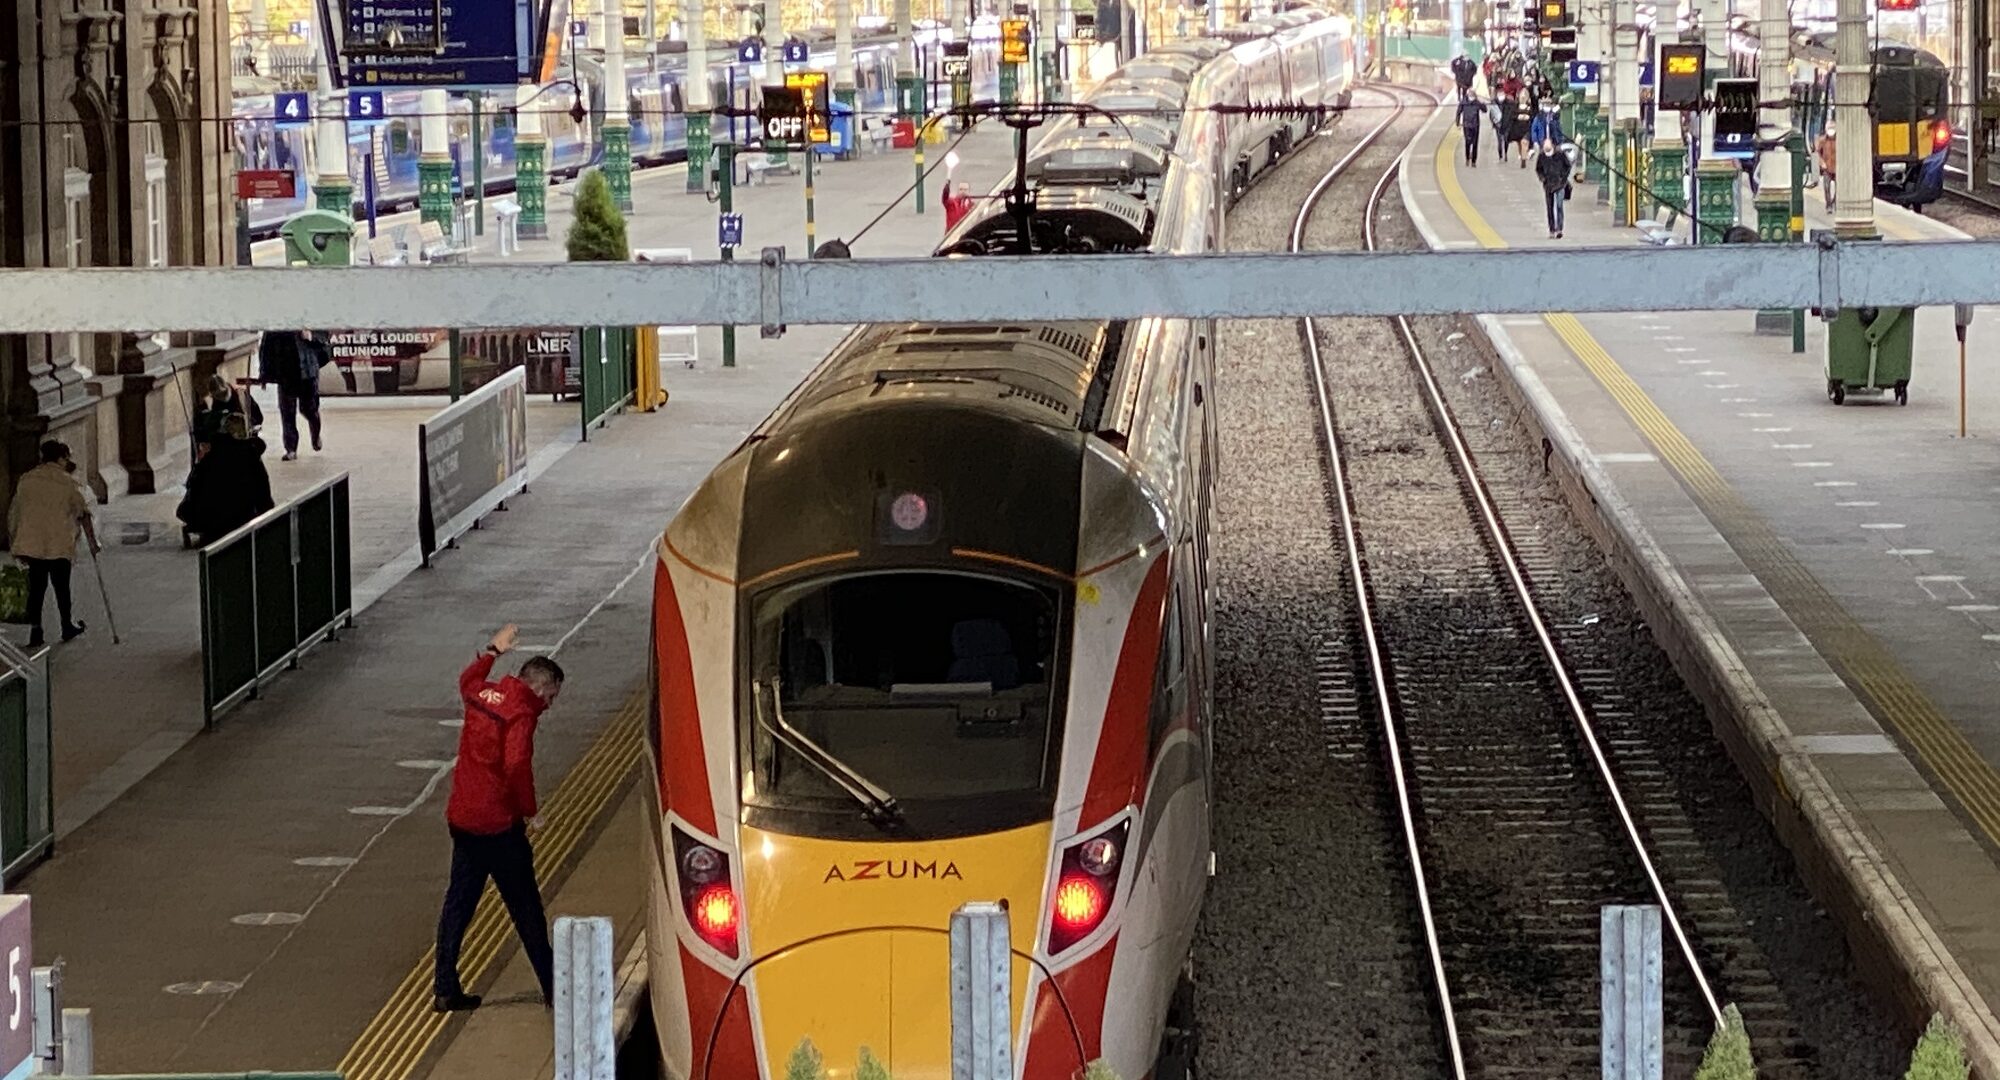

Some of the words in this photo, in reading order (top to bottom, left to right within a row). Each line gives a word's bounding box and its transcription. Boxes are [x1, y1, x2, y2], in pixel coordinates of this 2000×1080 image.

[1077, 28, 1095, 38] OFF
[745, 46, 754, 59] 4
[792, 46, 801, 59] 5
[945, 62, 967, 76] OFF
[1577, 64, 1588, 79] 6
[285, 98, 299, 117] 4
[360, 97, 372, 114] 5
[768, 118, 802, 138] OFF
[330, 333, 378, 344] ASTLE'S
[381, 333, 436, 344] LOUDEST
[527, 337, 571, 355] LNER
[333, 346, 396, 357] REUNIONS
[823, 860, 963, 884] AZUMA
[9, 946, 21, 1031] 5
